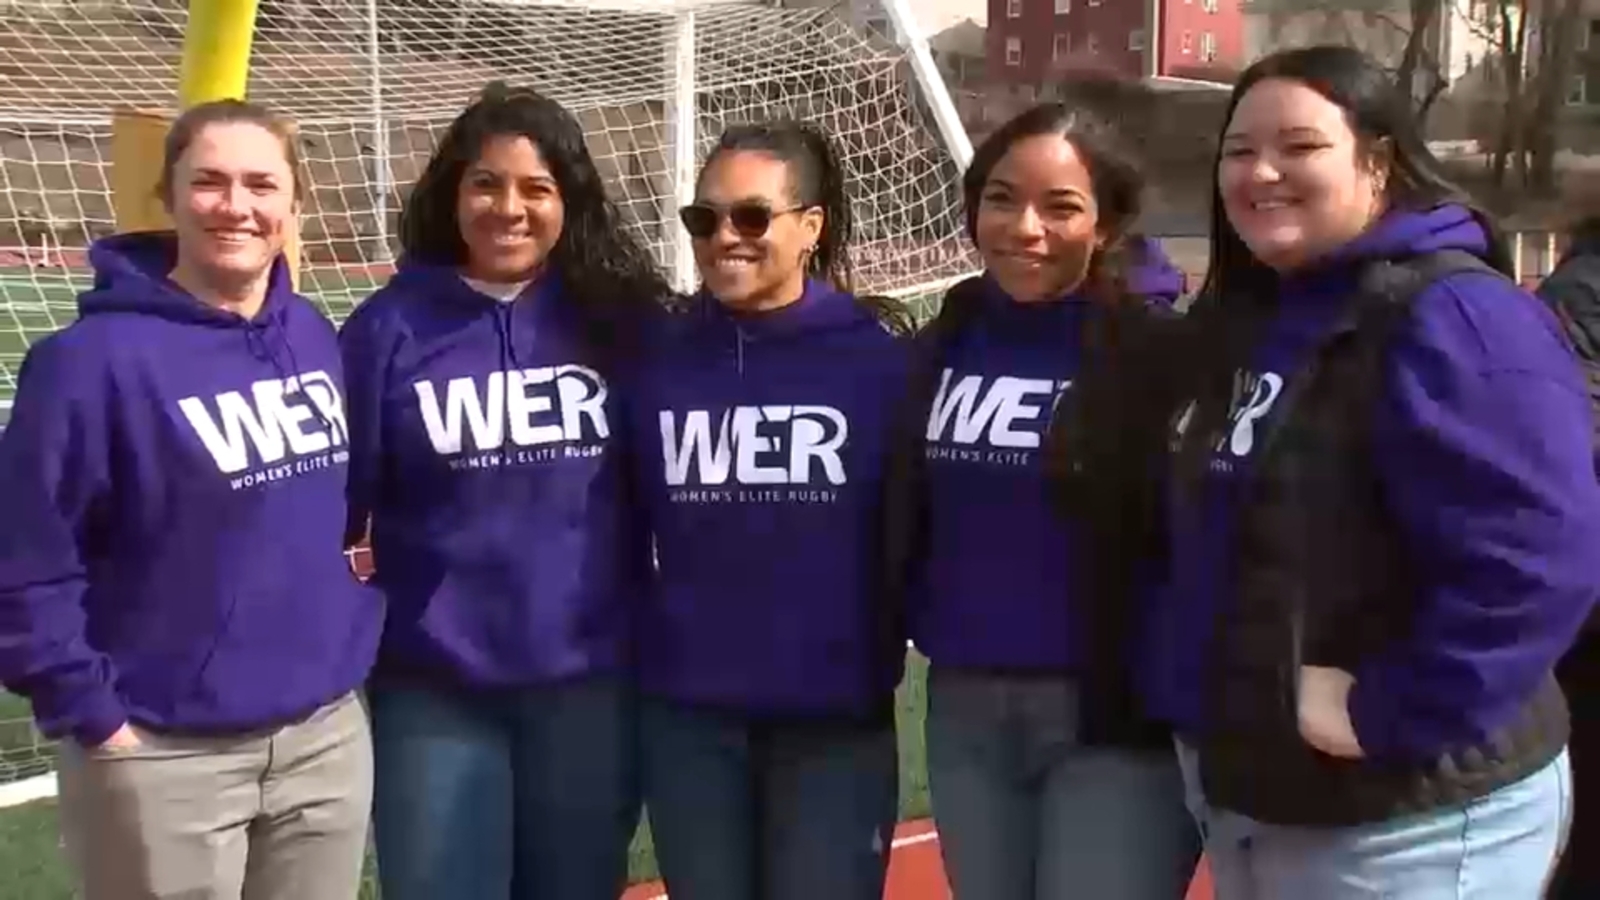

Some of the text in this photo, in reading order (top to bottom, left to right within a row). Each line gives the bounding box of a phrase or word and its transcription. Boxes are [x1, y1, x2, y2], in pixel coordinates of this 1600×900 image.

[177, 370, 349, 474] WER
[413, 364, 610, 454] WER
[659, 405, 848, 485] WER
[926, 368, 1073, 448] WE
[230, 464, 293, 491] WOMEN'S
[296, 455, 329, 474] ELITE
[517, 448, 556, 463] ELITE
[739, 490, 780, 502] ELITE
[788, 490, 838, 503] RUGBY
